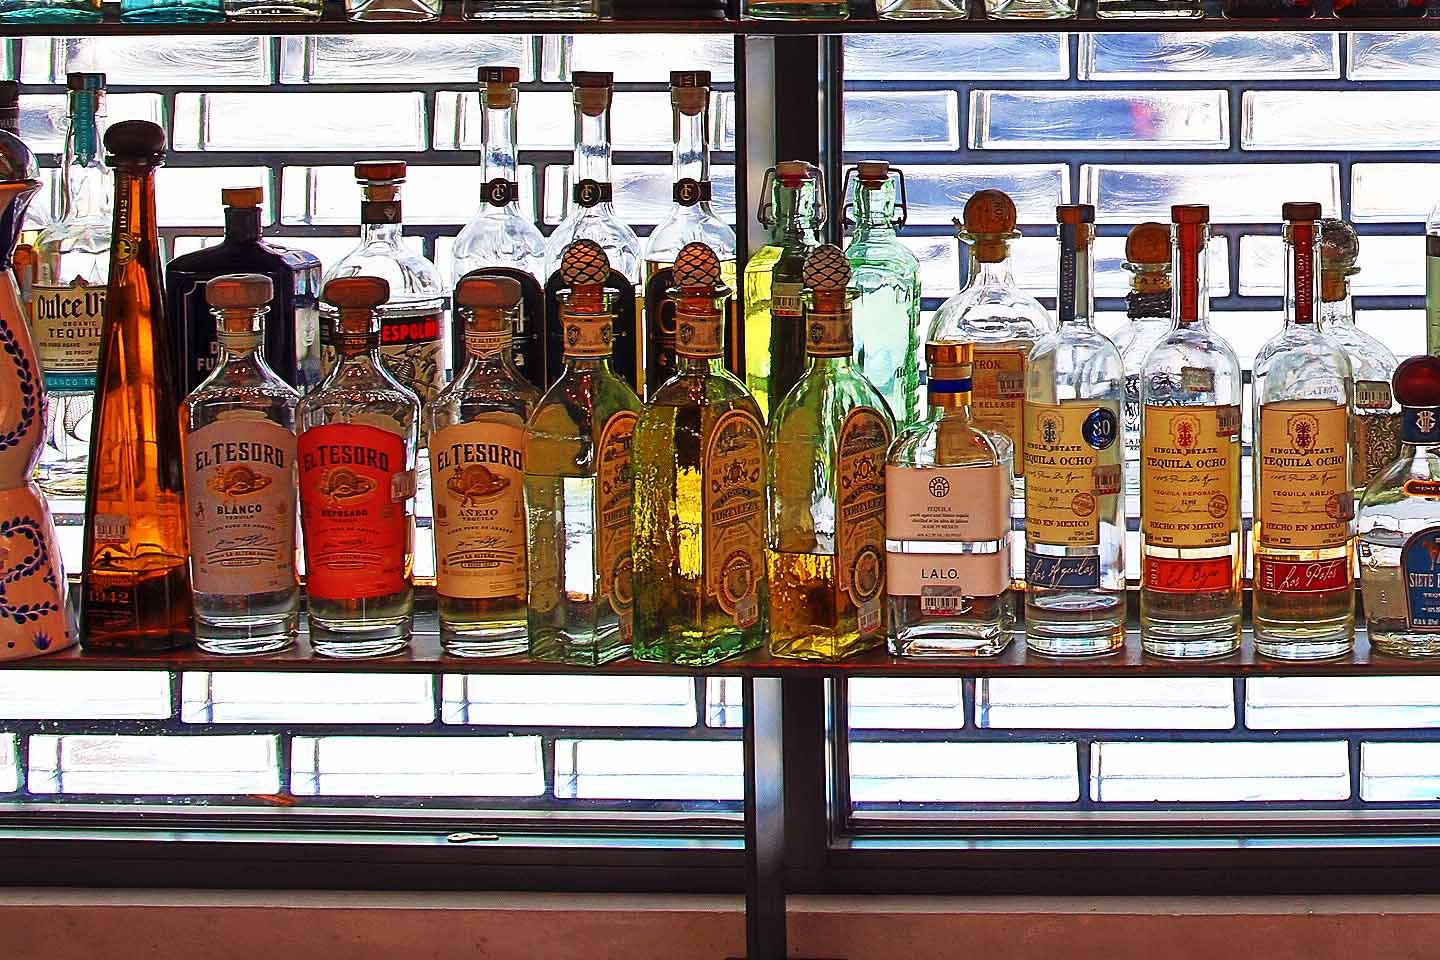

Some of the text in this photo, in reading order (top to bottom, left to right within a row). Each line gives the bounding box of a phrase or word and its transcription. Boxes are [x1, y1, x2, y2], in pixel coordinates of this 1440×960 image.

[48, 328, 102, 338] TEQUIL
[195, 443, 284, 470] EL TESORO
[316, 446, 388, 470] TESORO
[437, 443, 522, 470] EL TESORO
[1060, 457, 1092, 466] OCHO
[1264, 456, 1343, 468] TEQUILA OCHO
[1147, 457, 1226, 469] TEQUILA OCHO
[217, 505, 262, 514] BLANCO
[1308, 522, 1342, 530] MEXICO
[1410, 572, 1434, 588] SIETE
